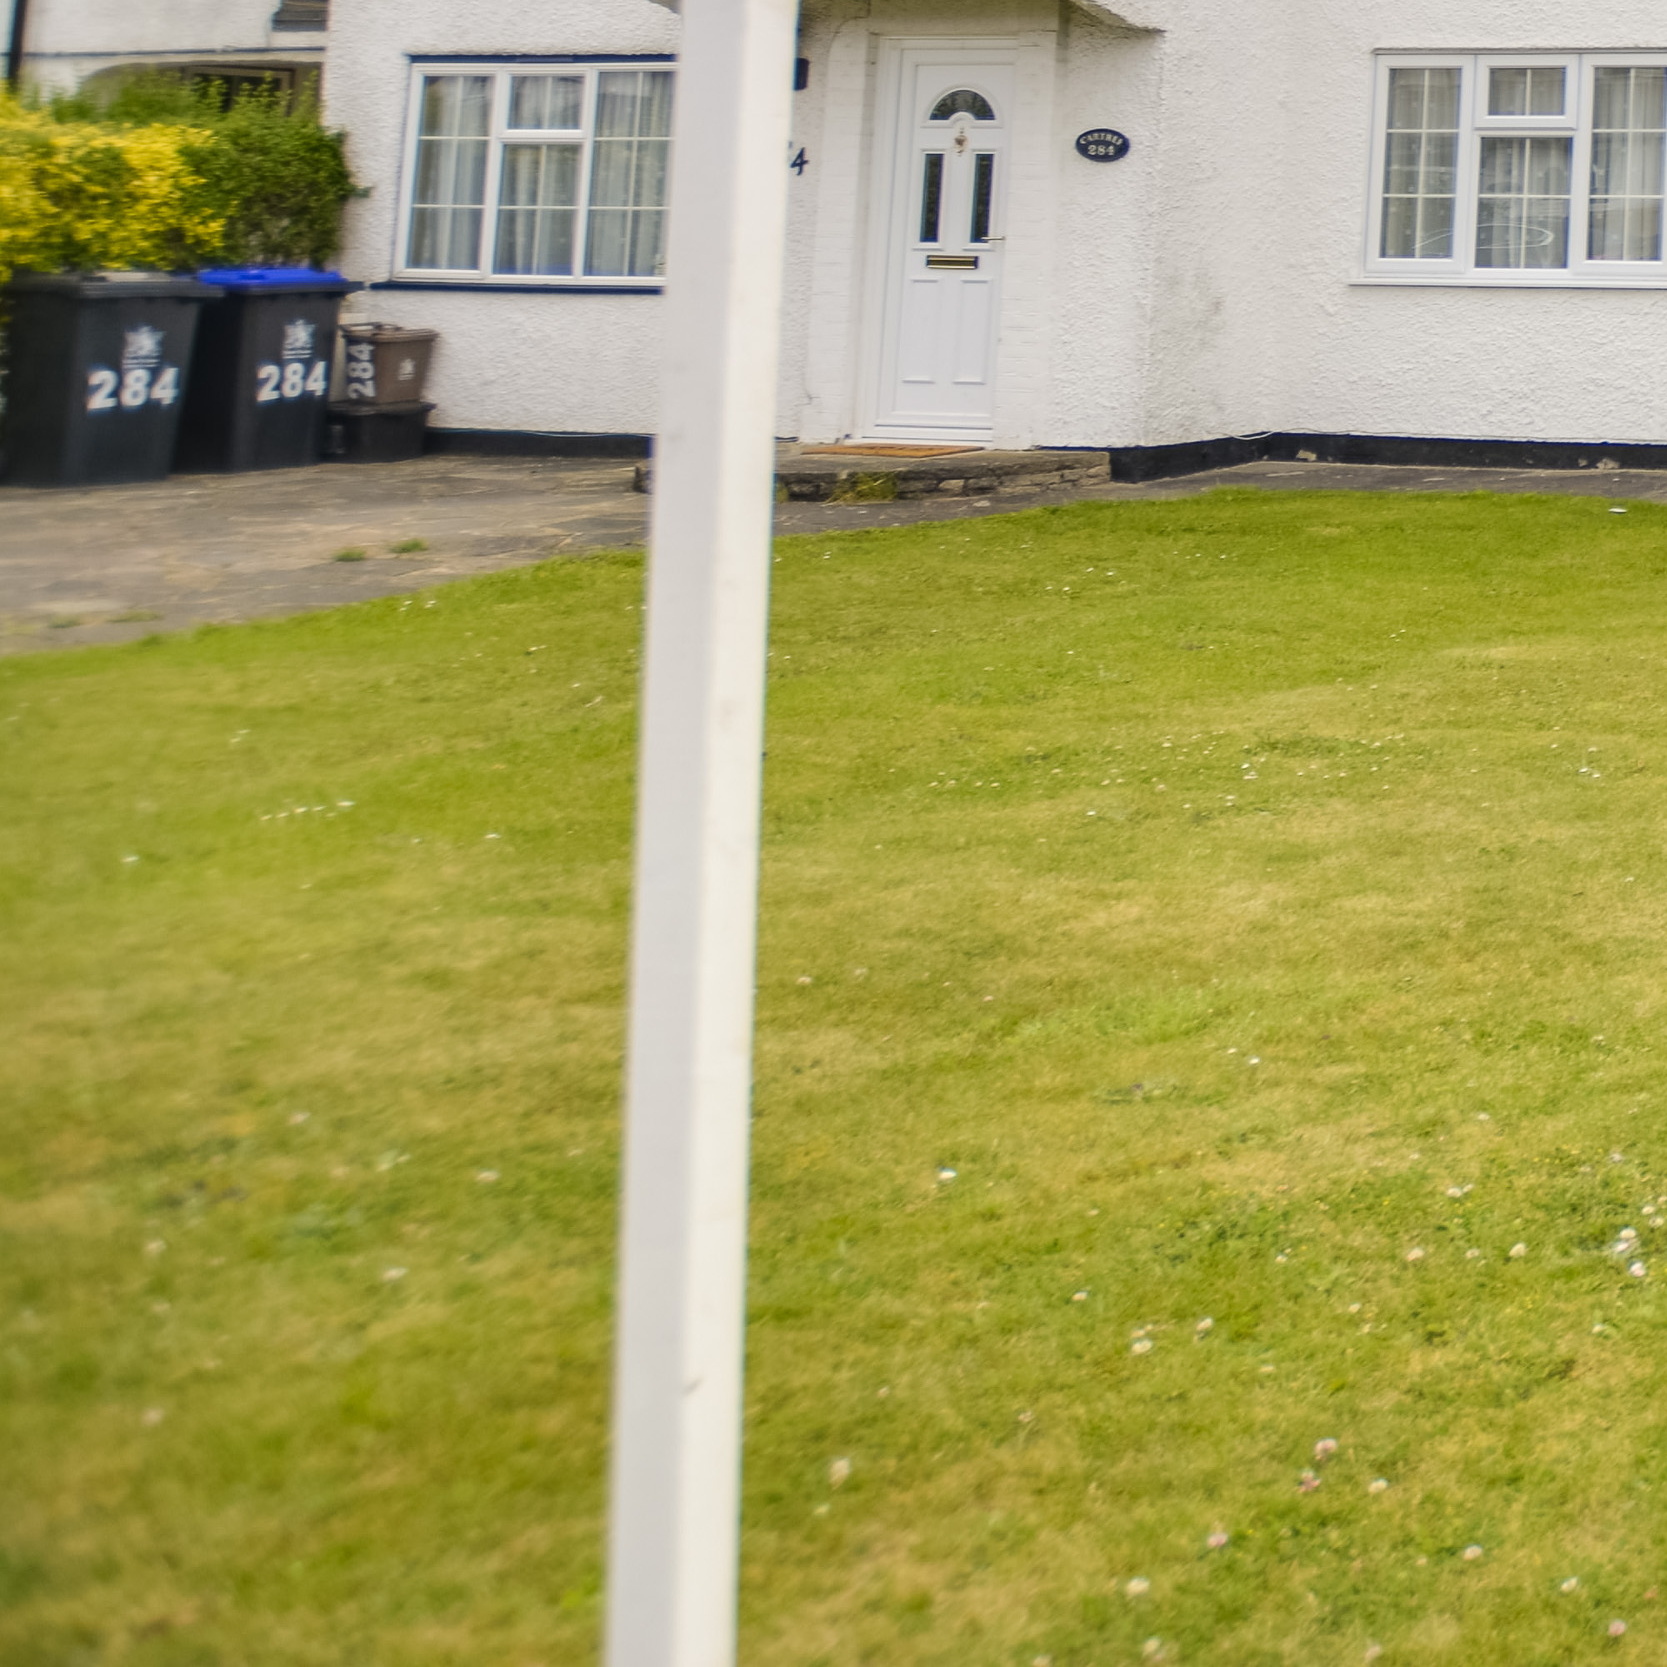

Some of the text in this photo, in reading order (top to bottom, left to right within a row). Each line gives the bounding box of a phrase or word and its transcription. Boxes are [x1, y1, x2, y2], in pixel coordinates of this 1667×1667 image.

[1088, 144, 1115, 156] 284
[86, 366, 179, 412] 284
[256, 360, 327, 402] 284
[348, 344, 376, 399] 284
